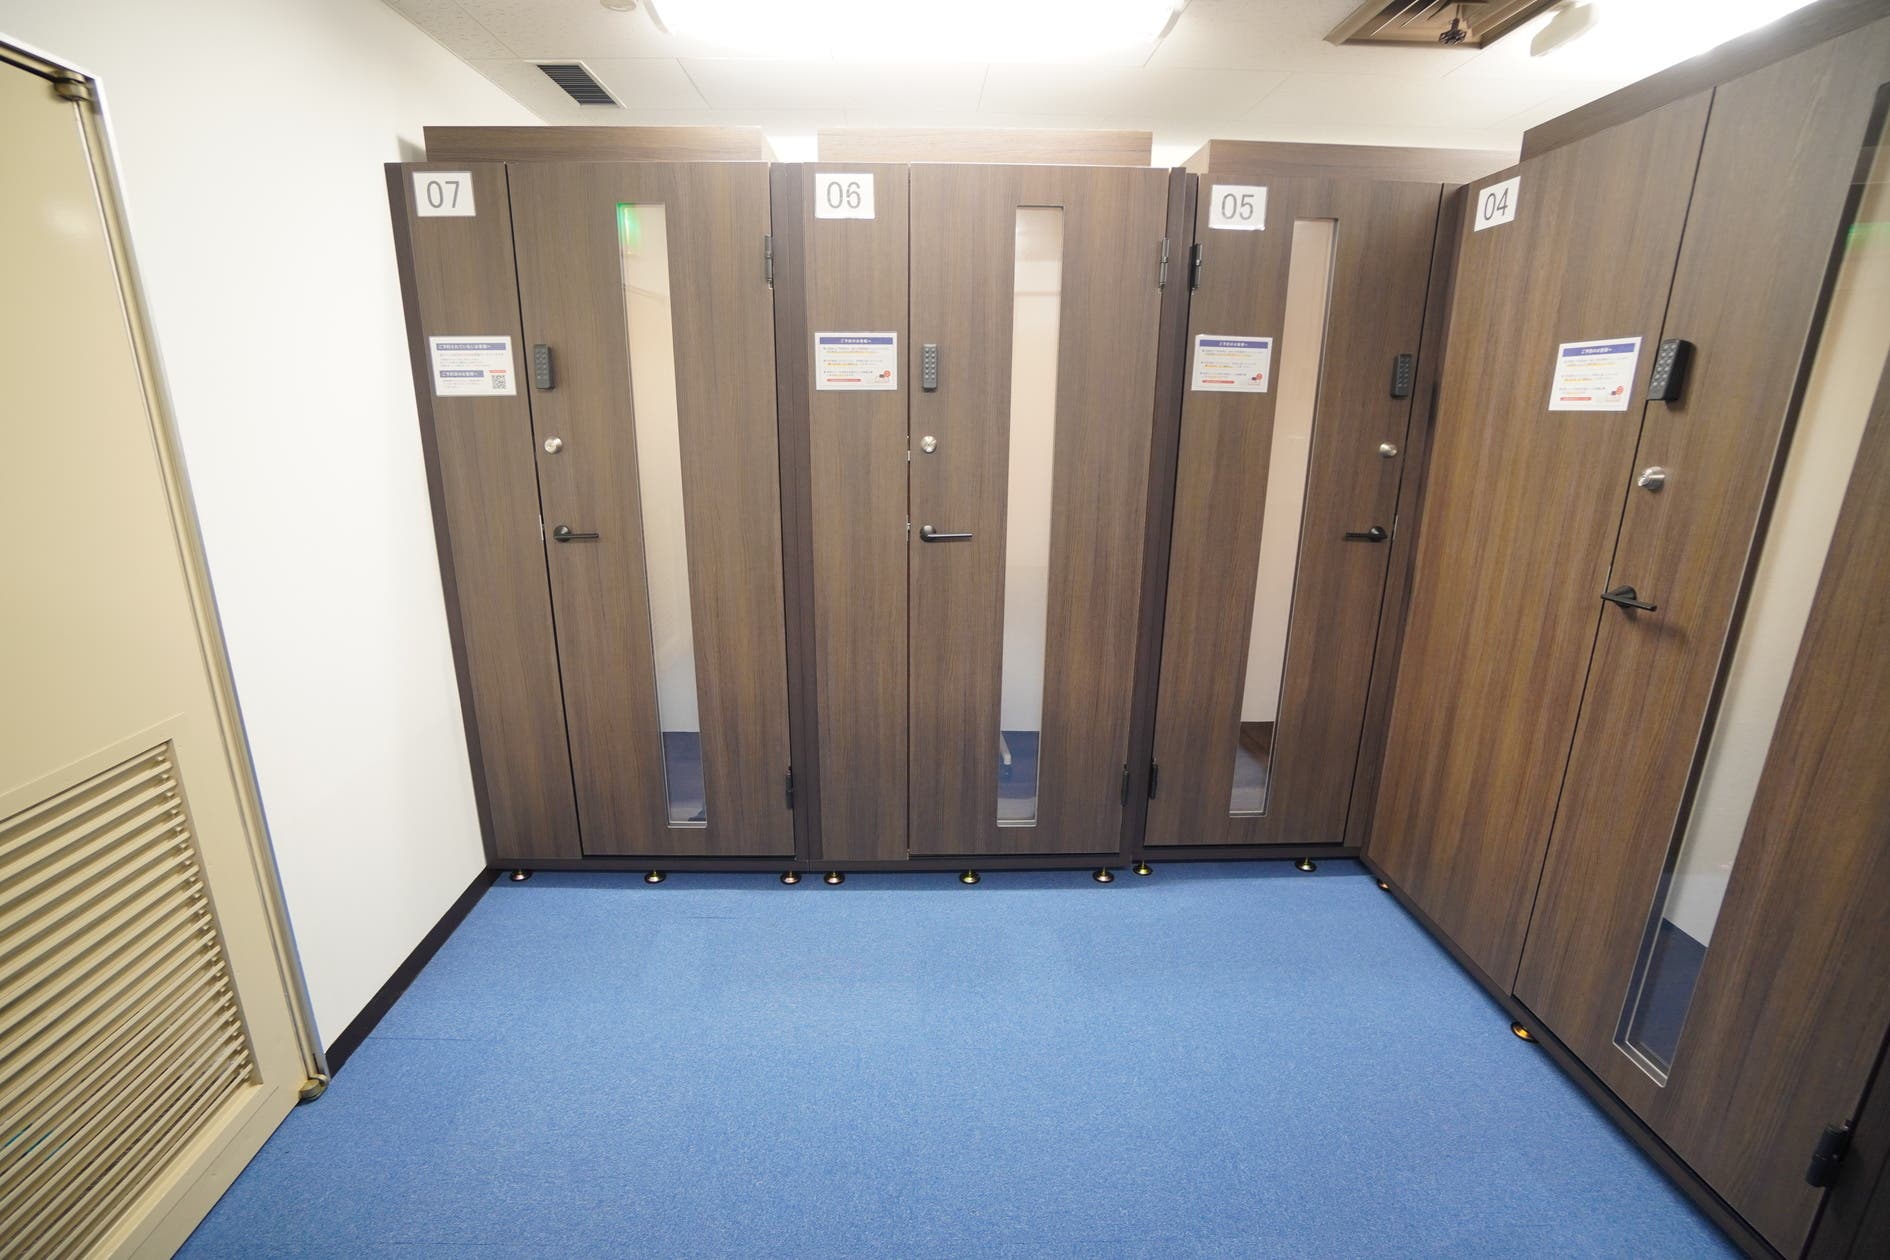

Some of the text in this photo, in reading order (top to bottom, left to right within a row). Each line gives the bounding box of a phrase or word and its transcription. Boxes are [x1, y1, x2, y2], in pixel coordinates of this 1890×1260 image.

[426, 180, 460, 209] 07
[827, 181, 863, 209] 06
[1221, 193, 1254, 220] 05
[1483, 188, 1509, 221] 04
